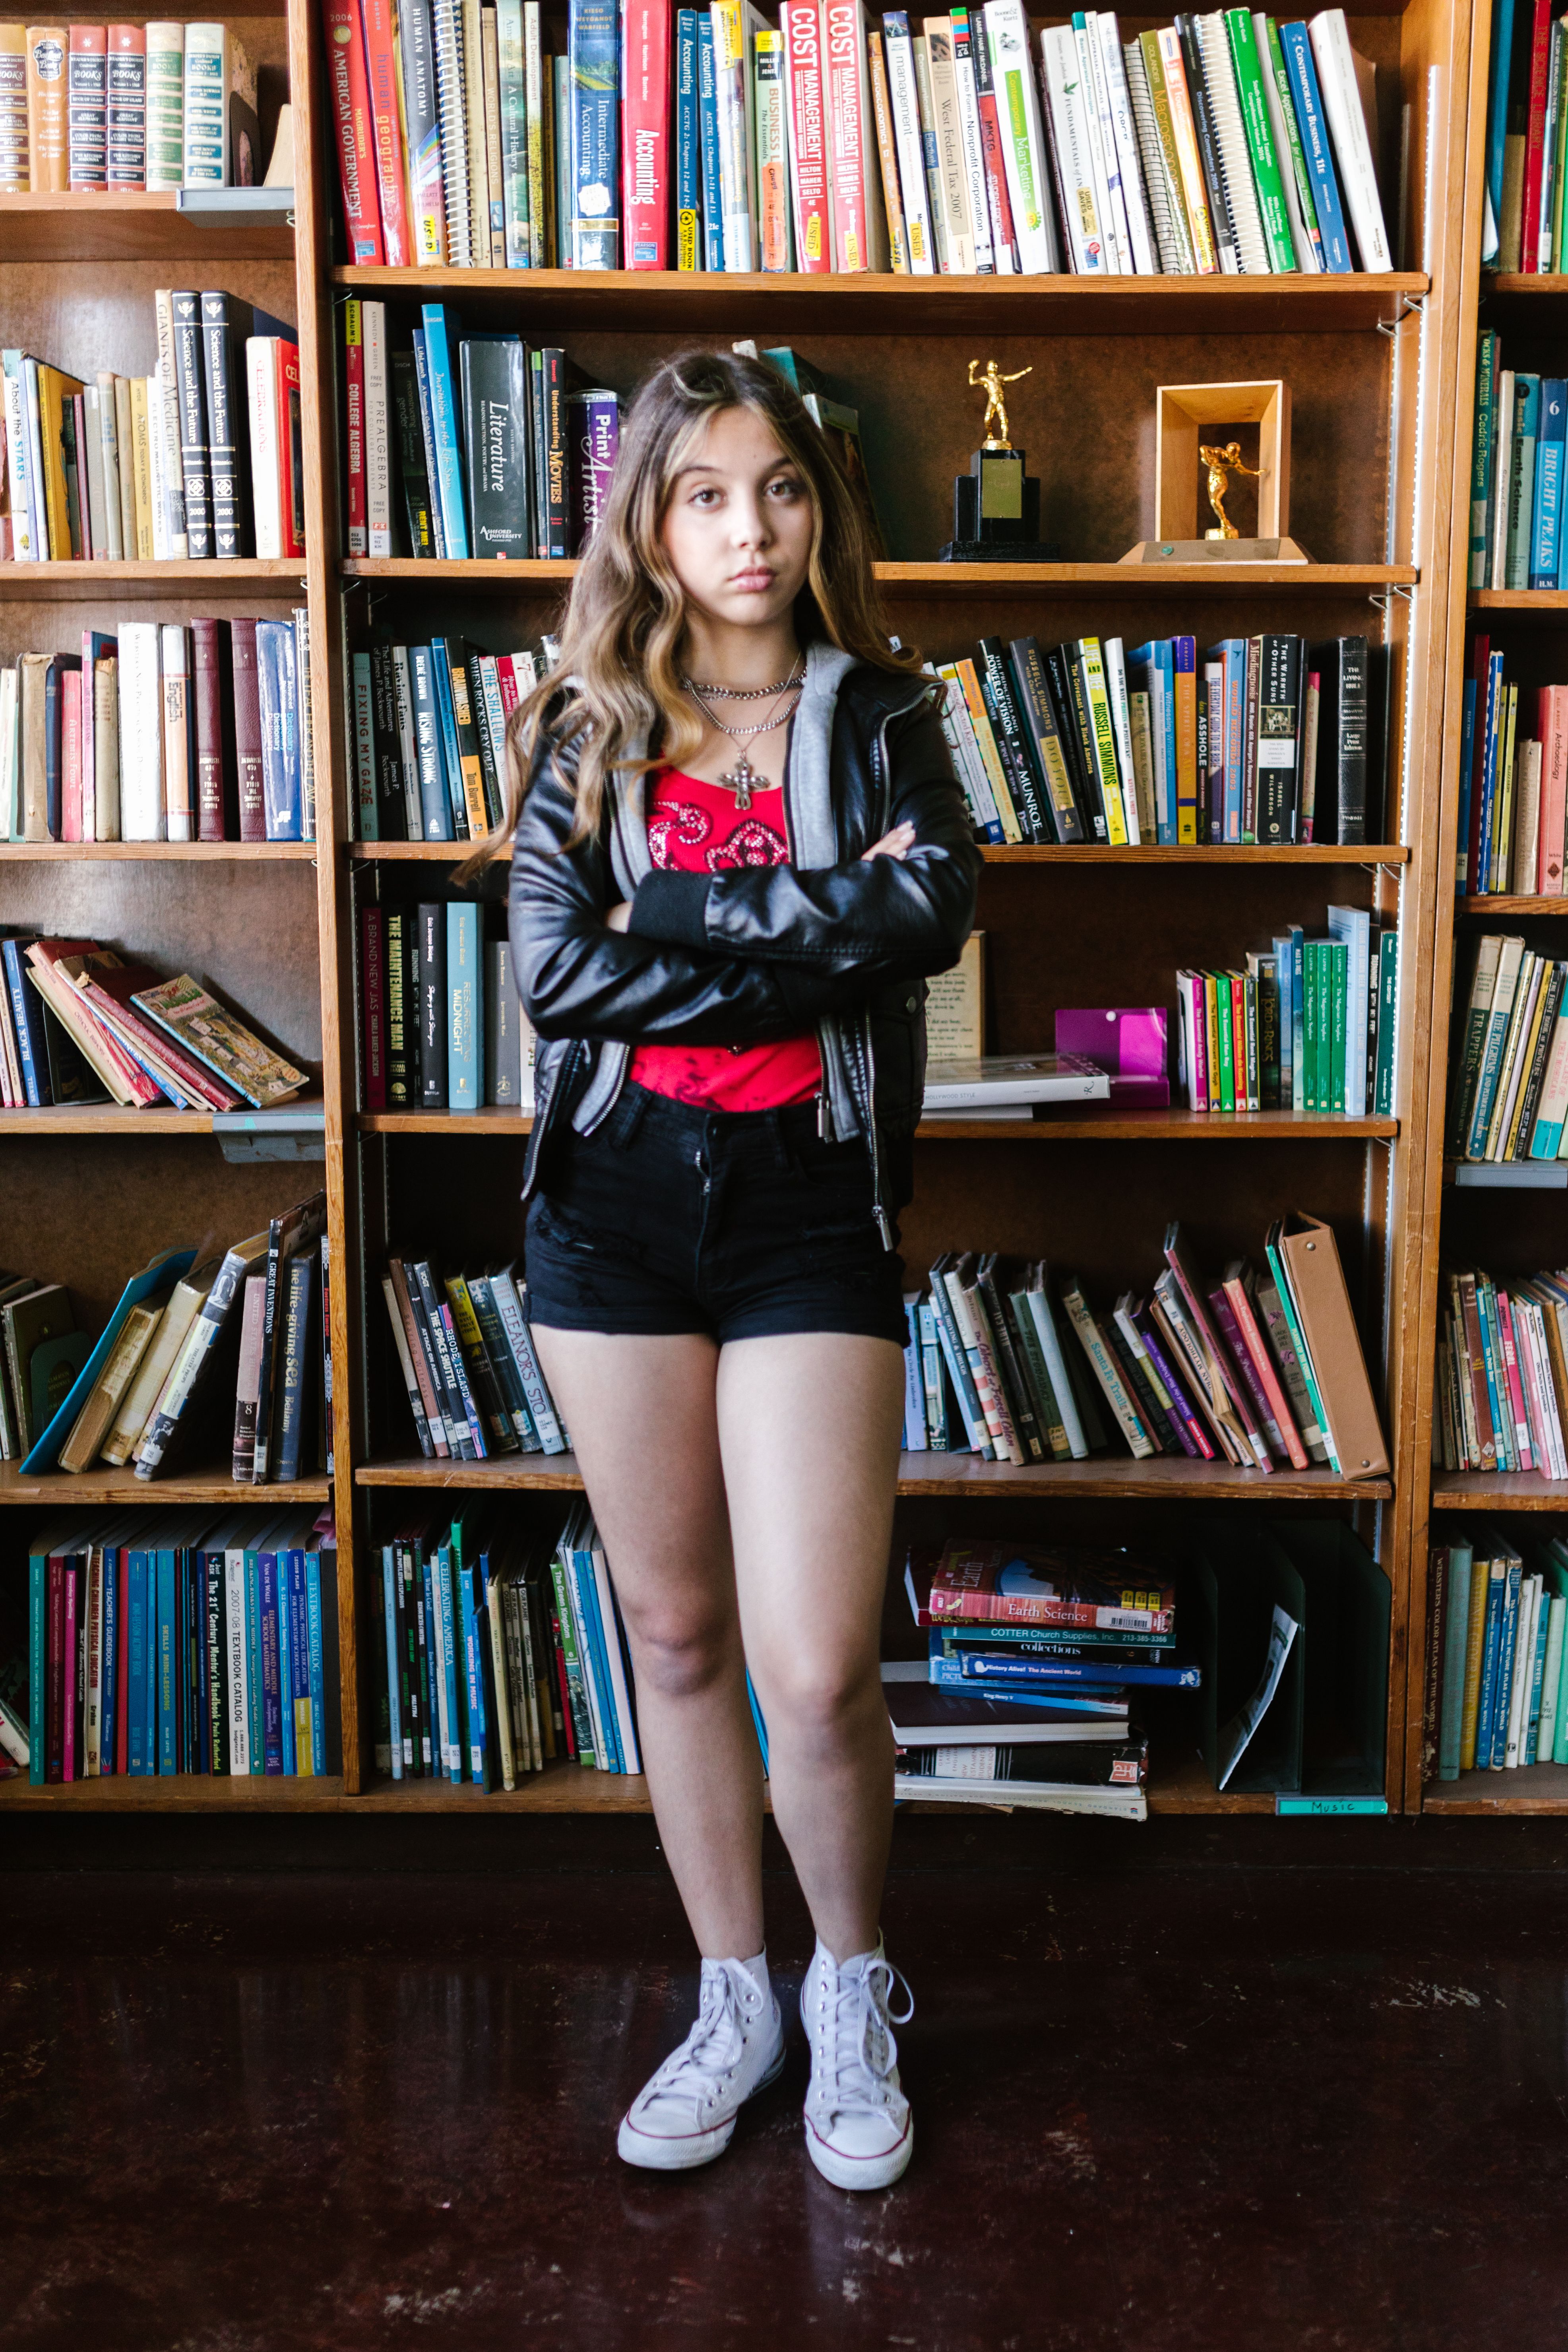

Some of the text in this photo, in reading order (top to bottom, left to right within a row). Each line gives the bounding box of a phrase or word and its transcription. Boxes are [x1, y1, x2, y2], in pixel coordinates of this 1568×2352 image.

[413, 8, 427, 117] HUMAN ANATOMY
[681, 39, 693, 94] Accounting
[702, 43, 713, 98] Accounting
[791, 8, 821, 160] COST MANAGEMENT
[830, 6, 859, 157] COST MANAGEMENT
[509, 97, 518, 133] Cultural
[769, 87, 780, 146] BUSINESS
[872, 60, 888, 144] Macroeconomics
[896, 56, 913, 135] management
[334, 49, 362, 218] AMERICAN GOVERNMENT
[355, 108, 366, 159] MAGRUDER'S
[376, 54, 397, 204] human geography
[487, 87, 499, 185] WORLD'S RELIGIONS
[508, 136, 519, 169] History
[580, 104, 594, 175] Accounting
[597, 100, 610, 178] Intermediate
[967, 121, 979, 169] Nonprofit
[985, 120, 995, 151] MKTG
[1008, 72, 1033, 199] Contemporary Marketing
[630, 129, 660, 205] Accounting
[942, 99, 961, 219] West Federal Tax 2007
[971, 172, 985, 231] Corporation
[808, 221, 817, 249] USED
[847, 238, 857, 266] USED
[912, 227, 921, 256] USED
[11, 382, 20, 417] About
[157, 304, 178, 456] GIANTS OF Medicine
[211, 330, 226, 444] Science and the Future
[349, 384, 361, 474] COLLEGE ALGEBRA
[376, 401, 386, 490] PREALGEBRA
[489, 400, 509, 492] Literature
[549, 390, 563, 504] Understanding MOVIES
[1477, 413, 1488, 487] Cedric Rogers
[15, 441, 24, 481] STARS
[581, 415, 614, 524] Print Artist
[1513, 438, 1524, 529] Earth Science
[419, 511, 428, 545] RENT ME!
[1541, 447, 1557, 567] BRIGHT PEAKS
[451, 667, 471, 725] BRAINWASHED
[1073, 679, 1083, 708] Covenant
[1248, 645, 1260, 699] Misdiagnosis
[167, 682, 180, 722] English
[469, 656, 493, 772] WHEN ROCKS CRY OUT
[483, 667, 505, 752] THE SHALLOWS
[358, 684, 373, 805] FIXING MY GAZE
[1081, 727, 1089, 745] Black
[1084, 747, 1093, 774] America
[1093, 703, 1116, 785] RUSSELL SIMMONS
[1199, 716, 1207, 766] ASSHOLE
[467, 772, 480, 812] Tom Burrell
[1019, 770, 1043, 830] MUNROE
[368, 925, 377, 960] BRAND
[369, 964, 378, 988] NEW
[388, 915, 403, 1050] THE MAINTENANCE MAN
[12, 988, 30, 1061] BLACK BEAUTY
[453, 989, 462, 1054] MIDNIGHT
[266, 1262, 276, 1333] GREAT INVENTIONS
[430, 1311, 456, 1389] THE SPACE SHUTTLE
[445, 1328, 470, 1398] RHODE ISLAND
[501, 1305, 536, 1381] ELEANOR'S
[281, 1396, 293, 1433] Bellamy
[208, 1580, 218, 1594] The
[231, 1590, 240, 1629] 2007-08
[440, 1562, 454, 1666] CELEBRATING AMERICA
[556, 1586, 566, 1605] Green
[1008, 1604, 1087, 1622] Earth Science
[208, 1614, 219, 1644] Century
[559, 1608, 572, 1638] Kingdom
[991, 1628, 1029, 1637] COTTER
[1030, 1630, 1060, 1639] Church
[1062, 1631, 1099, 1640] Supplies,
[1122, 1635, 1167, 1643] 213-385-3366
[1021, 1643, 1081, 1655] collections
[210, 1647, 220, 1679] Mentor's
[233, 1632, 241, 1679] TEXTBOOK
[468, 1675, 476, 1683] IN
[211, 1682, 221, 1719] Handbook
[1312, 1802, 1355, 1813] Music
